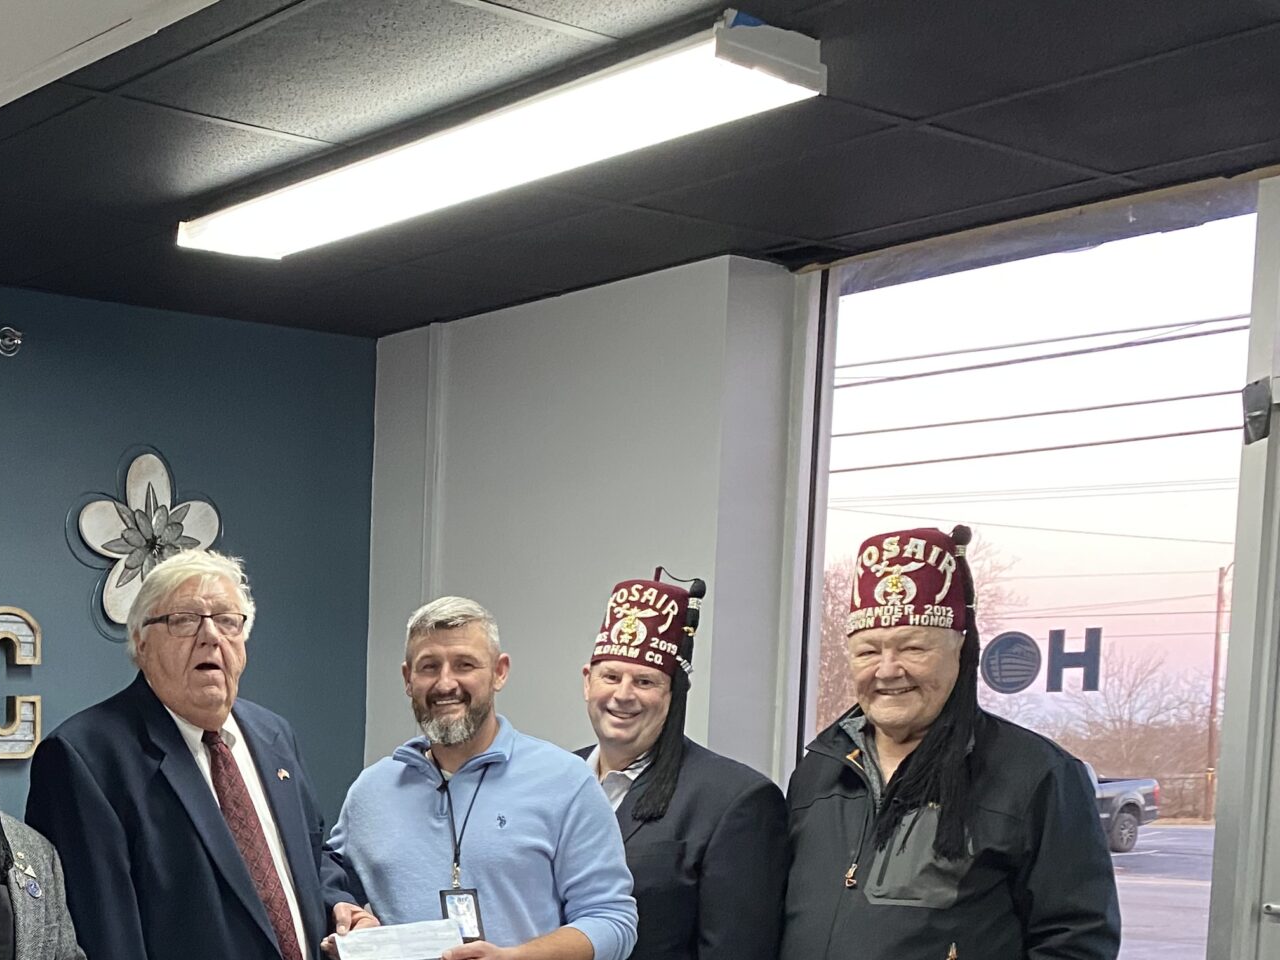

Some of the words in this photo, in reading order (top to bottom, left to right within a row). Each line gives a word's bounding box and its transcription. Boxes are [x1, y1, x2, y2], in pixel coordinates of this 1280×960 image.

[923, 604, 955, 618] 2012
[881, 615, 900, 627] OF
[909, 614, 954, 628] HONOR
[649, 637, 678, 655] 2019
